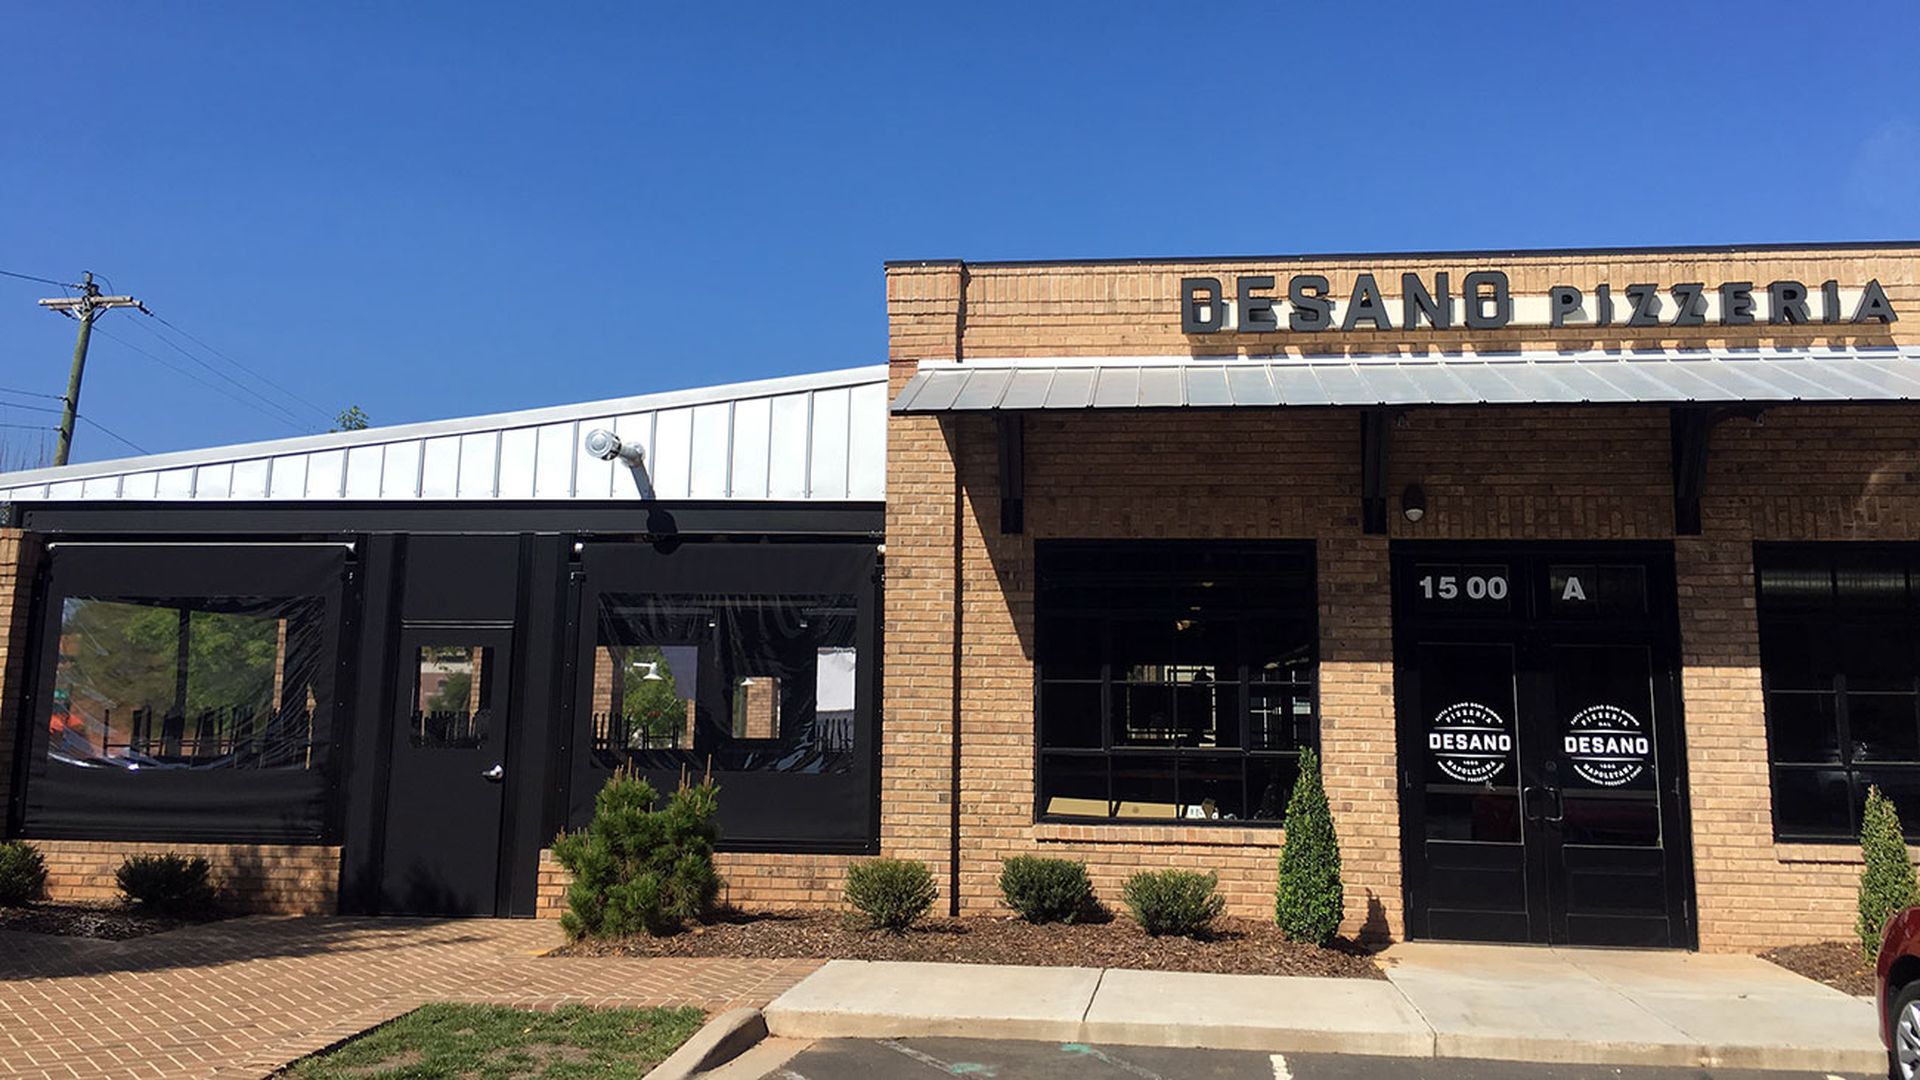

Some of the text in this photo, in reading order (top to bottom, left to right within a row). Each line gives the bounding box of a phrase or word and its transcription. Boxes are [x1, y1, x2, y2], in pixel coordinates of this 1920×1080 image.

[1181, 271, 1898, 333] DESANO PIZZERIA
[1419, 576, 1586, 600] 1500 A
[1445, 709, 1492, 724] PIZZERIA
[1581, 712, 1628, 727] PIZZERIA
[1428, 733, 1511, 752] DESANO
[1564, 736, 1649, 755] DESANO
[1446, 760, 1496, 776] NAPOLETANA
[1583, 763, 1634, 779] NAPOLETANA
